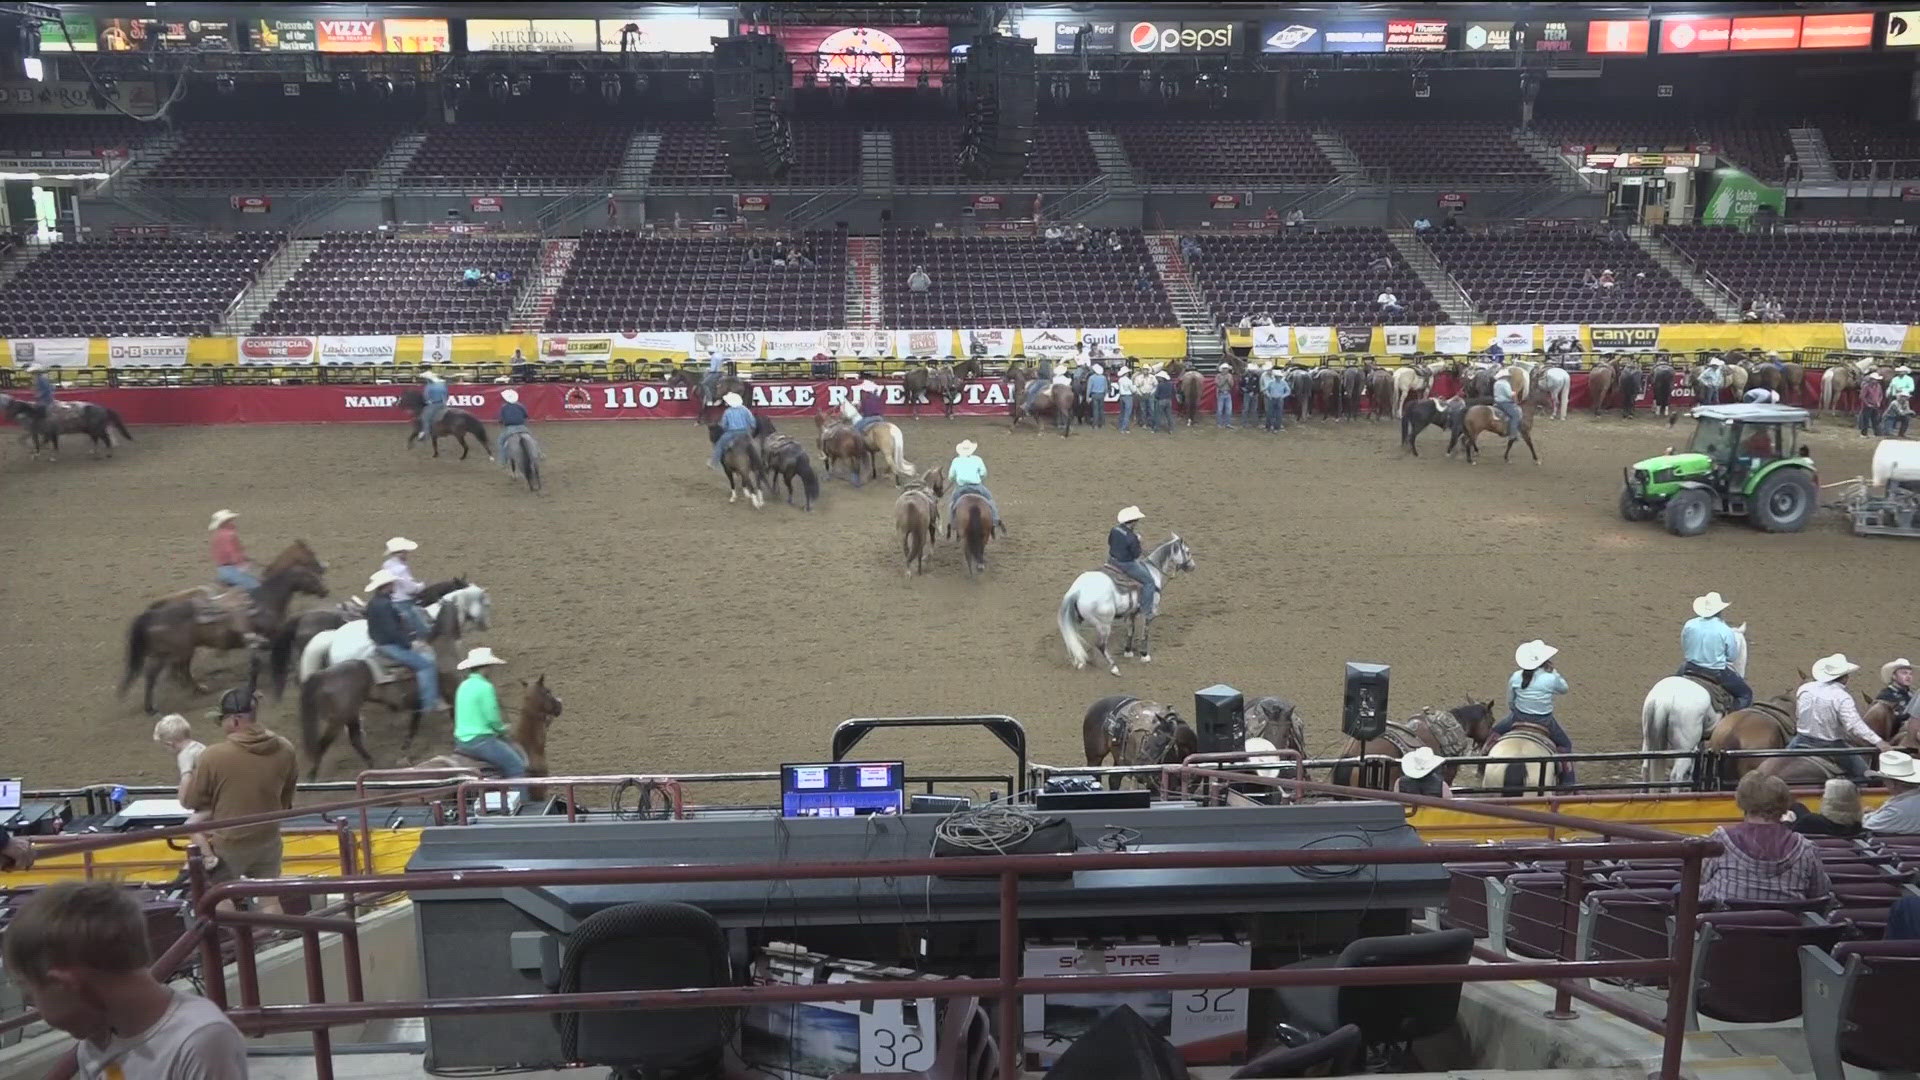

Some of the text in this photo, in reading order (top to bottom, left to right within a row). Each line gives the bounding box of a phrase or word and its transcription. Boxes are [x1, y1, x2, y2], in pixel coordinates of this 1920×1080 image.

[276, 21, 315, 30] Crossroads
[320, 21, 376, 36] VIZZY
[1094, 25, 1114, 34] Ford
[294, 32, 306, 40] the
[492, 31, 573, 43] MERIDIAN
[1160, 24, 1233, 51] pepsi
[1388, 35, 1407, 43] Auto
[280, 42, 315, 51] Northwest
[1736, 189, 1757, 201] Idaho
[1592, 329, 1656, 345] canyon
[1846, 327, 1873, 336] VISIT
[715, 333, 756, 342] IDAHO
[1082, 333, 1116, 345] Guild
[1386, 335, 1416, 346] ESI
[268, 348, 288, 356] TIRE
[716, 343, 756, 353] PRESS
[604, 387, 689, 408] 110TH
[1186, 988, 1236, 1013] 32
[874, 1028, 924, 1072] 32
